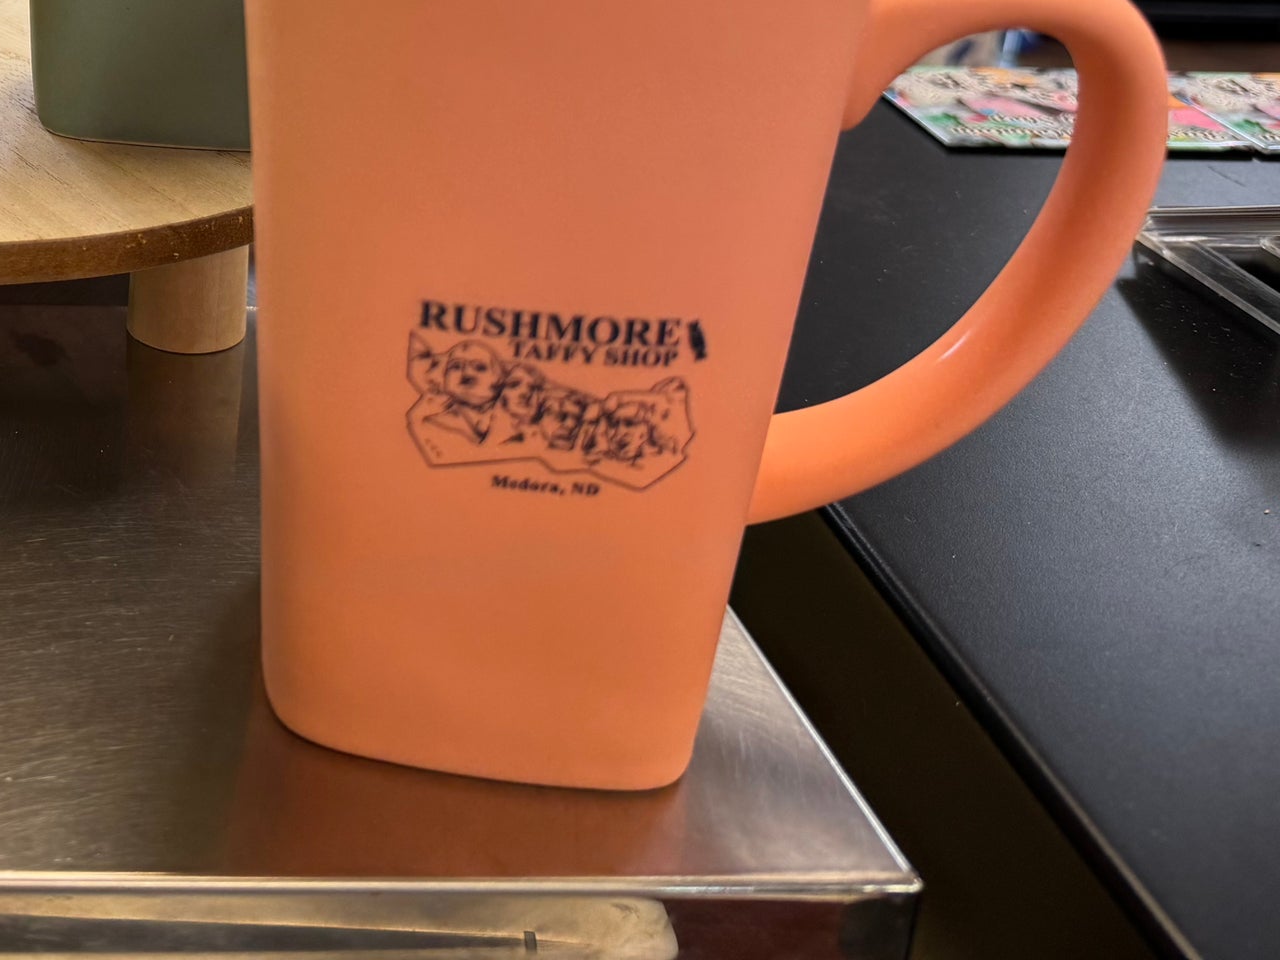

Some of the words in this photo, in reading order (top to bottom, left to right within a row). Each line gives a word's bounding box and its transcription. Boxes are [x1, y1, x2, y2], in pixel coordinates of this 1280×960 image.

[419, 300, 683, 347] RUSHMORE
[509, 340, 597, 364] TAFFY
[602, 343, 680, 368] SHOP
[490, 474, 566, 496] Medora,
[570, 481, 601, 496] ND
